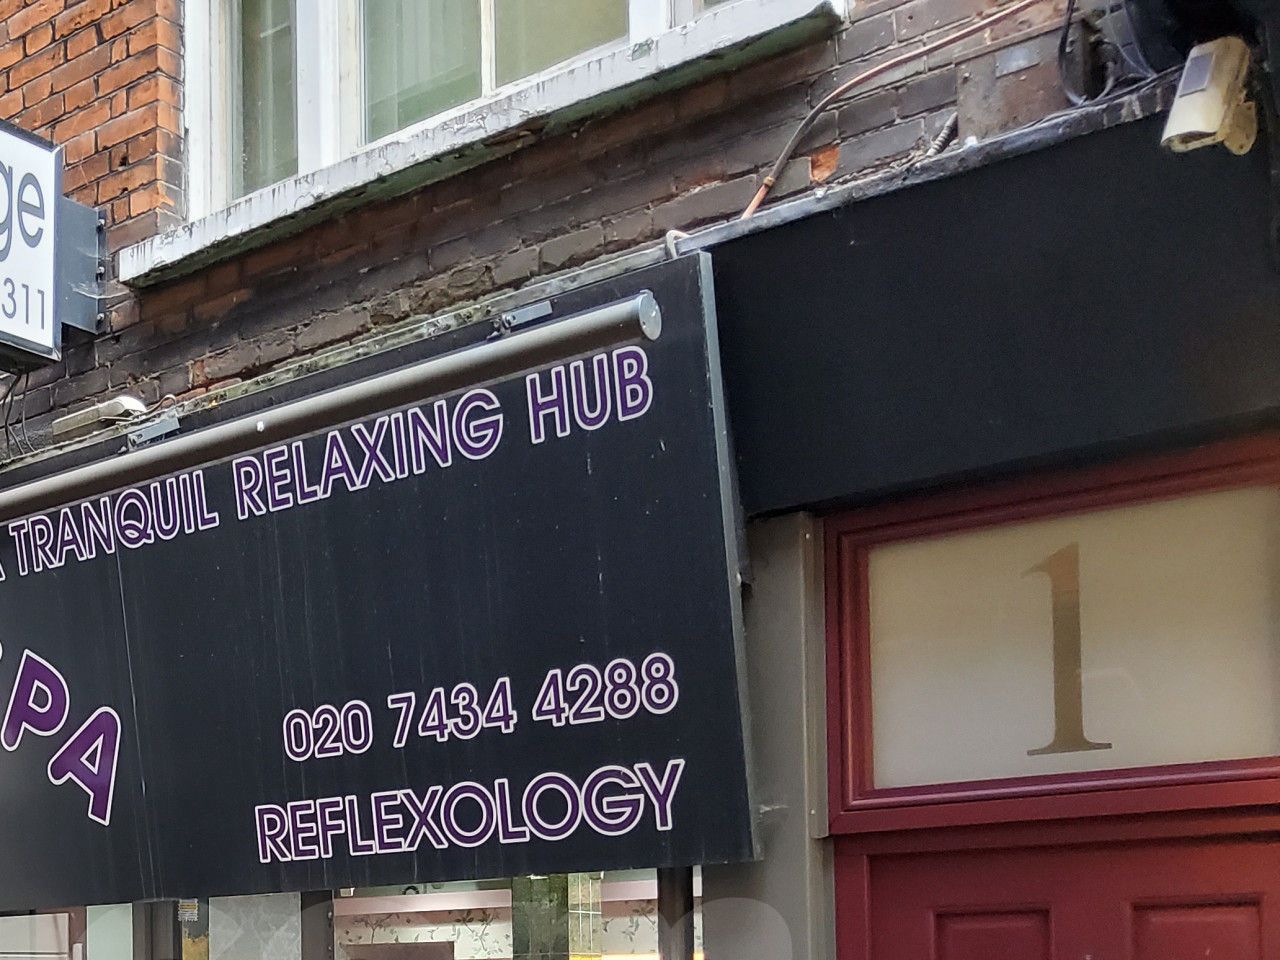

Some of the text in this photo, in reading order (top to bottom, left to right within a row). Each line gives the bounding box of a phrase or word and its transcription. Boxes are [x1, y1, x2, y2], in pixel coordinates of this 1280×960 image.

[8, 470, 220, 577] TRANQUIL
[232, 388, 504, 520] RELAXING
[525, 345, 654, 444] HUB
[282, 651, 680, 762] 020 7434 4288
[1021, 541, 1113, 757] 1
[254, 758, 686, 864] REFLEXOLOGY
